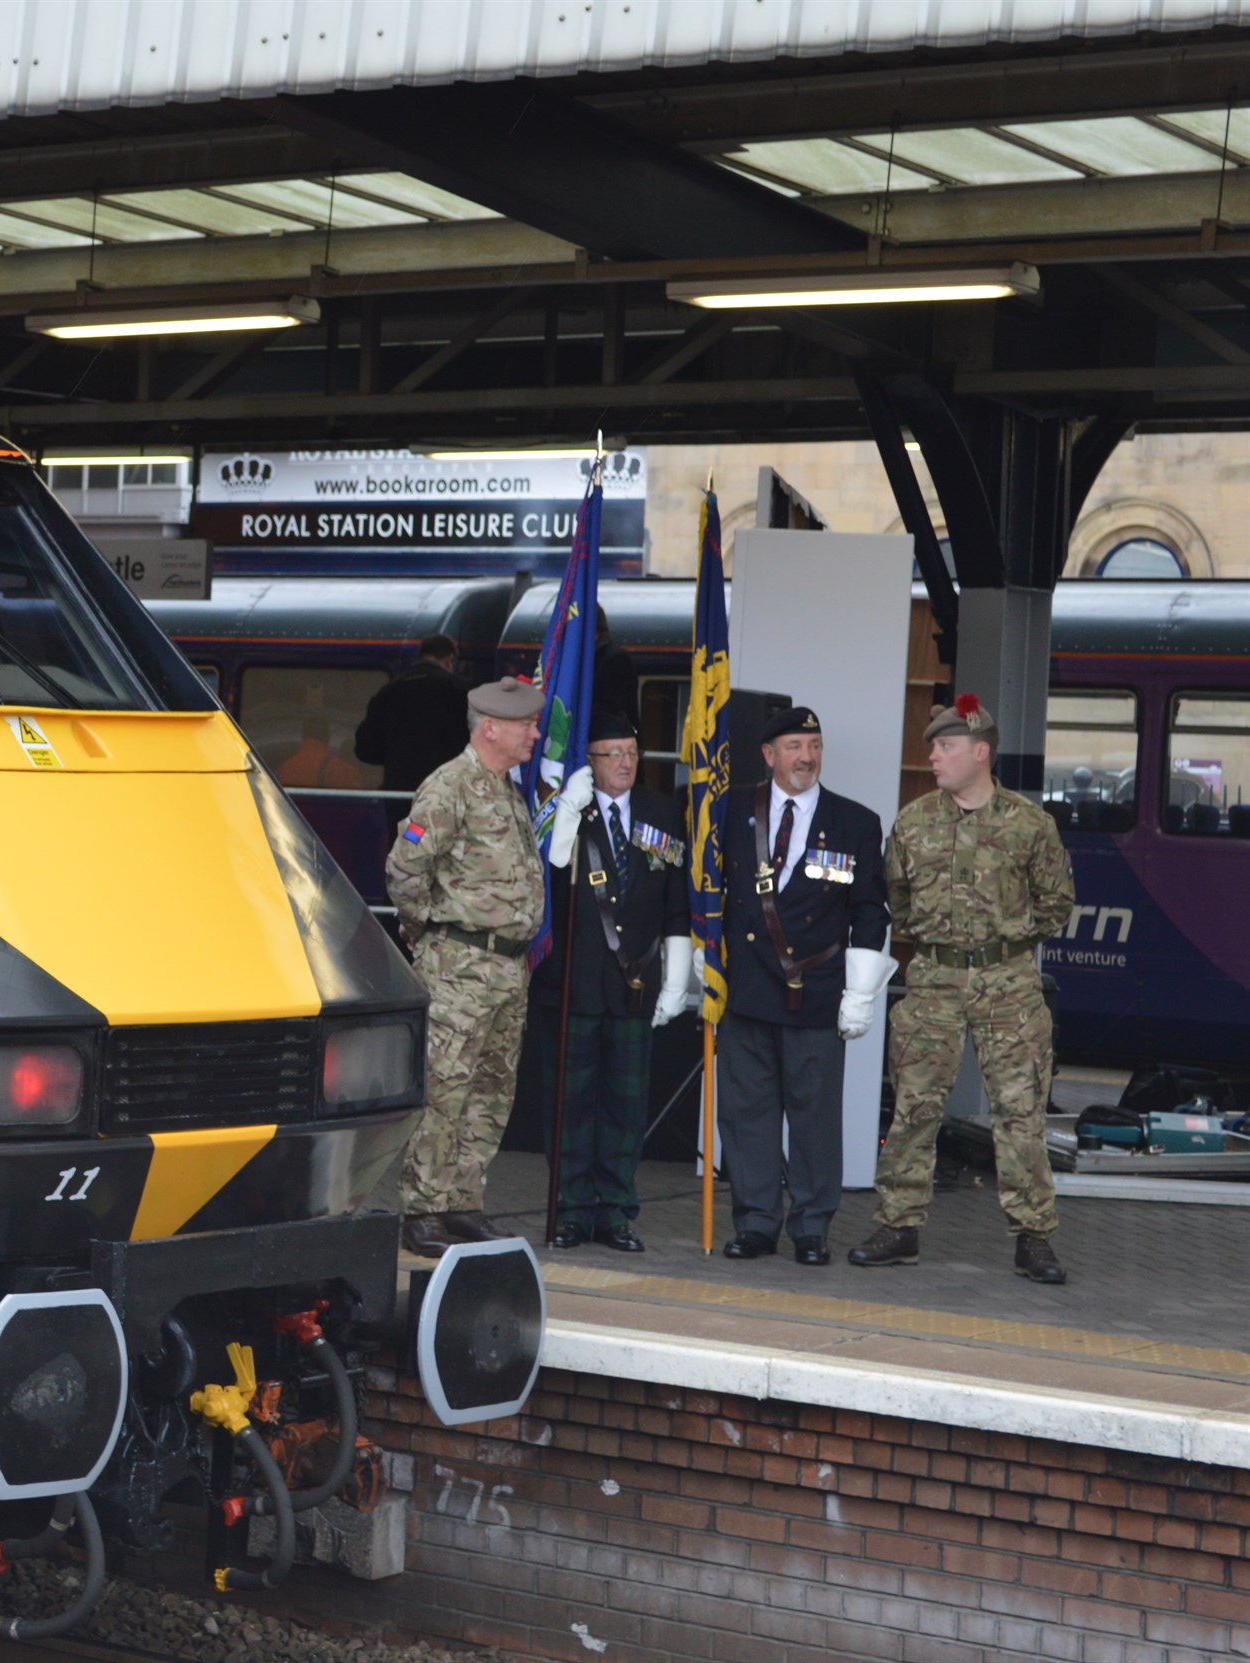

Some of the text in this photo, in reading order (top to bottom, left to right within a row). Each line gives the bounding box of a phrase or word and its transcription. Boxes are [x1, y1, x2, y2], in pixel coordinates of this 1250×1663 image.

[314, 475, 531, 495] www.bookaroom.com
[241, 513, 311, 538] ROYAL
[317, 513, 414, 538] STATION
[421, 513, 514, 538] LEISURE
[111, 554, 145, 581] tle
[1054, 905, 1133, 943] rn
[1067, 950, 1126, 967] venture
[45, 1166, 101, 1201] 11
